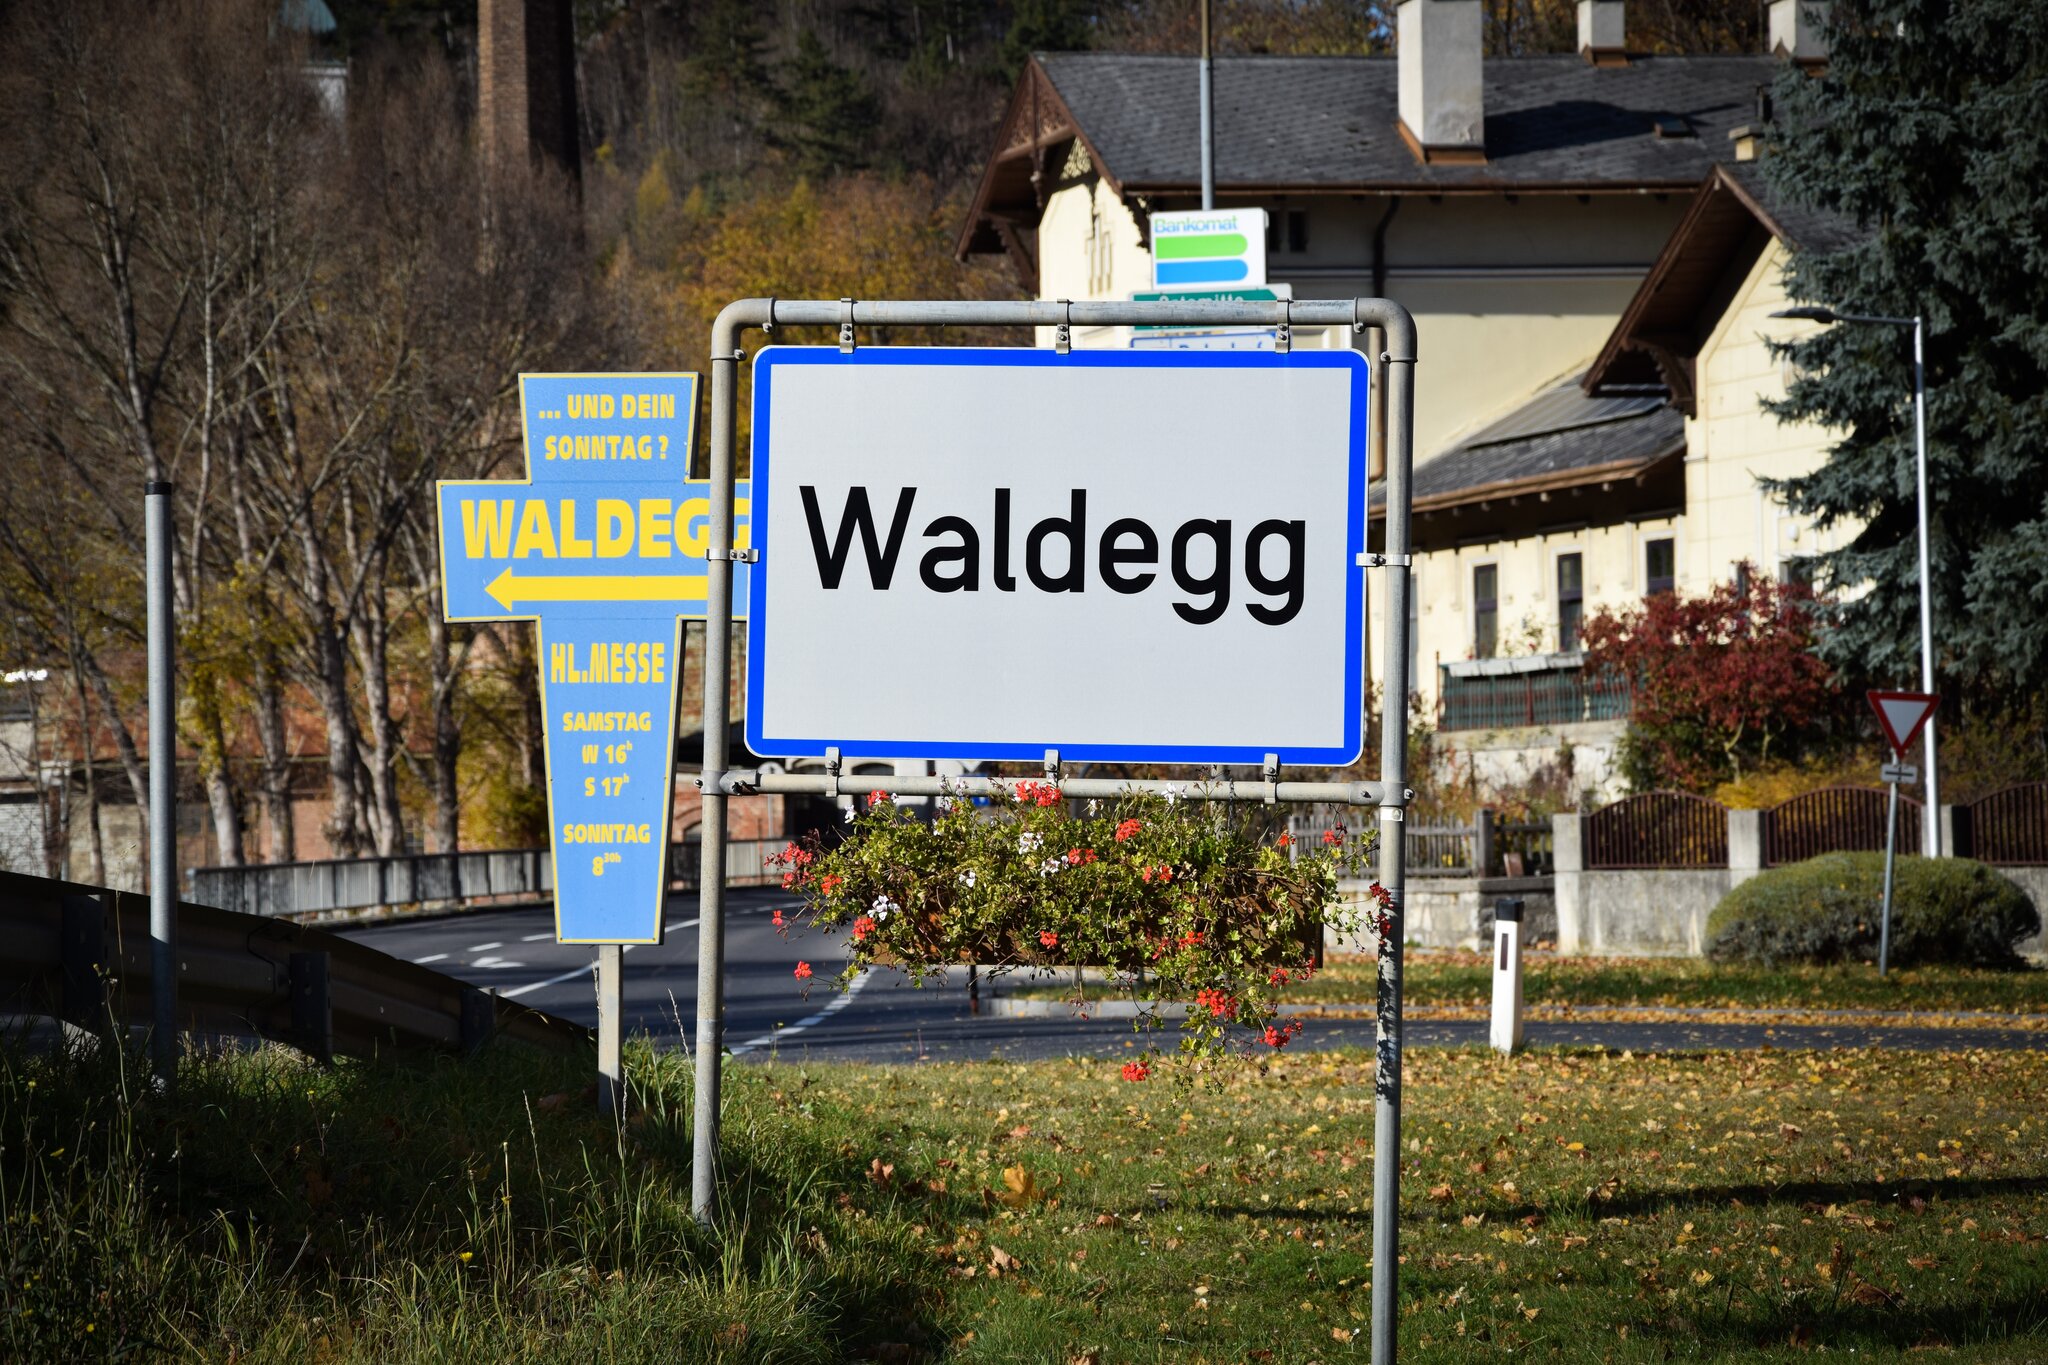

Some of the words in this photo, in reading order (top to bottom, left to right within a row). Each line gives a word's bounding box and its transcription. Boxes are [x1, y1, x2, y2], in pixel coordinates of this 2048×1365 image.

[1154, 215, 1238, 233] Bankomat
[567, 394, 615, 418] UND
[622, 394, 675, 418] DEIN
[545, 435, 652, 460] SONNTAG
[658, 435, 669, 460] ?
[799, 486, 1306, 625] Waldegg
[551, 643, 665, 684] HL.MESSE
[563, 712, 651, 731] SAMSTAG
[581, 744, 599, 764] W
[584, 777, 596, 797] S
[563, 824, 651, 844] SONNTAG
